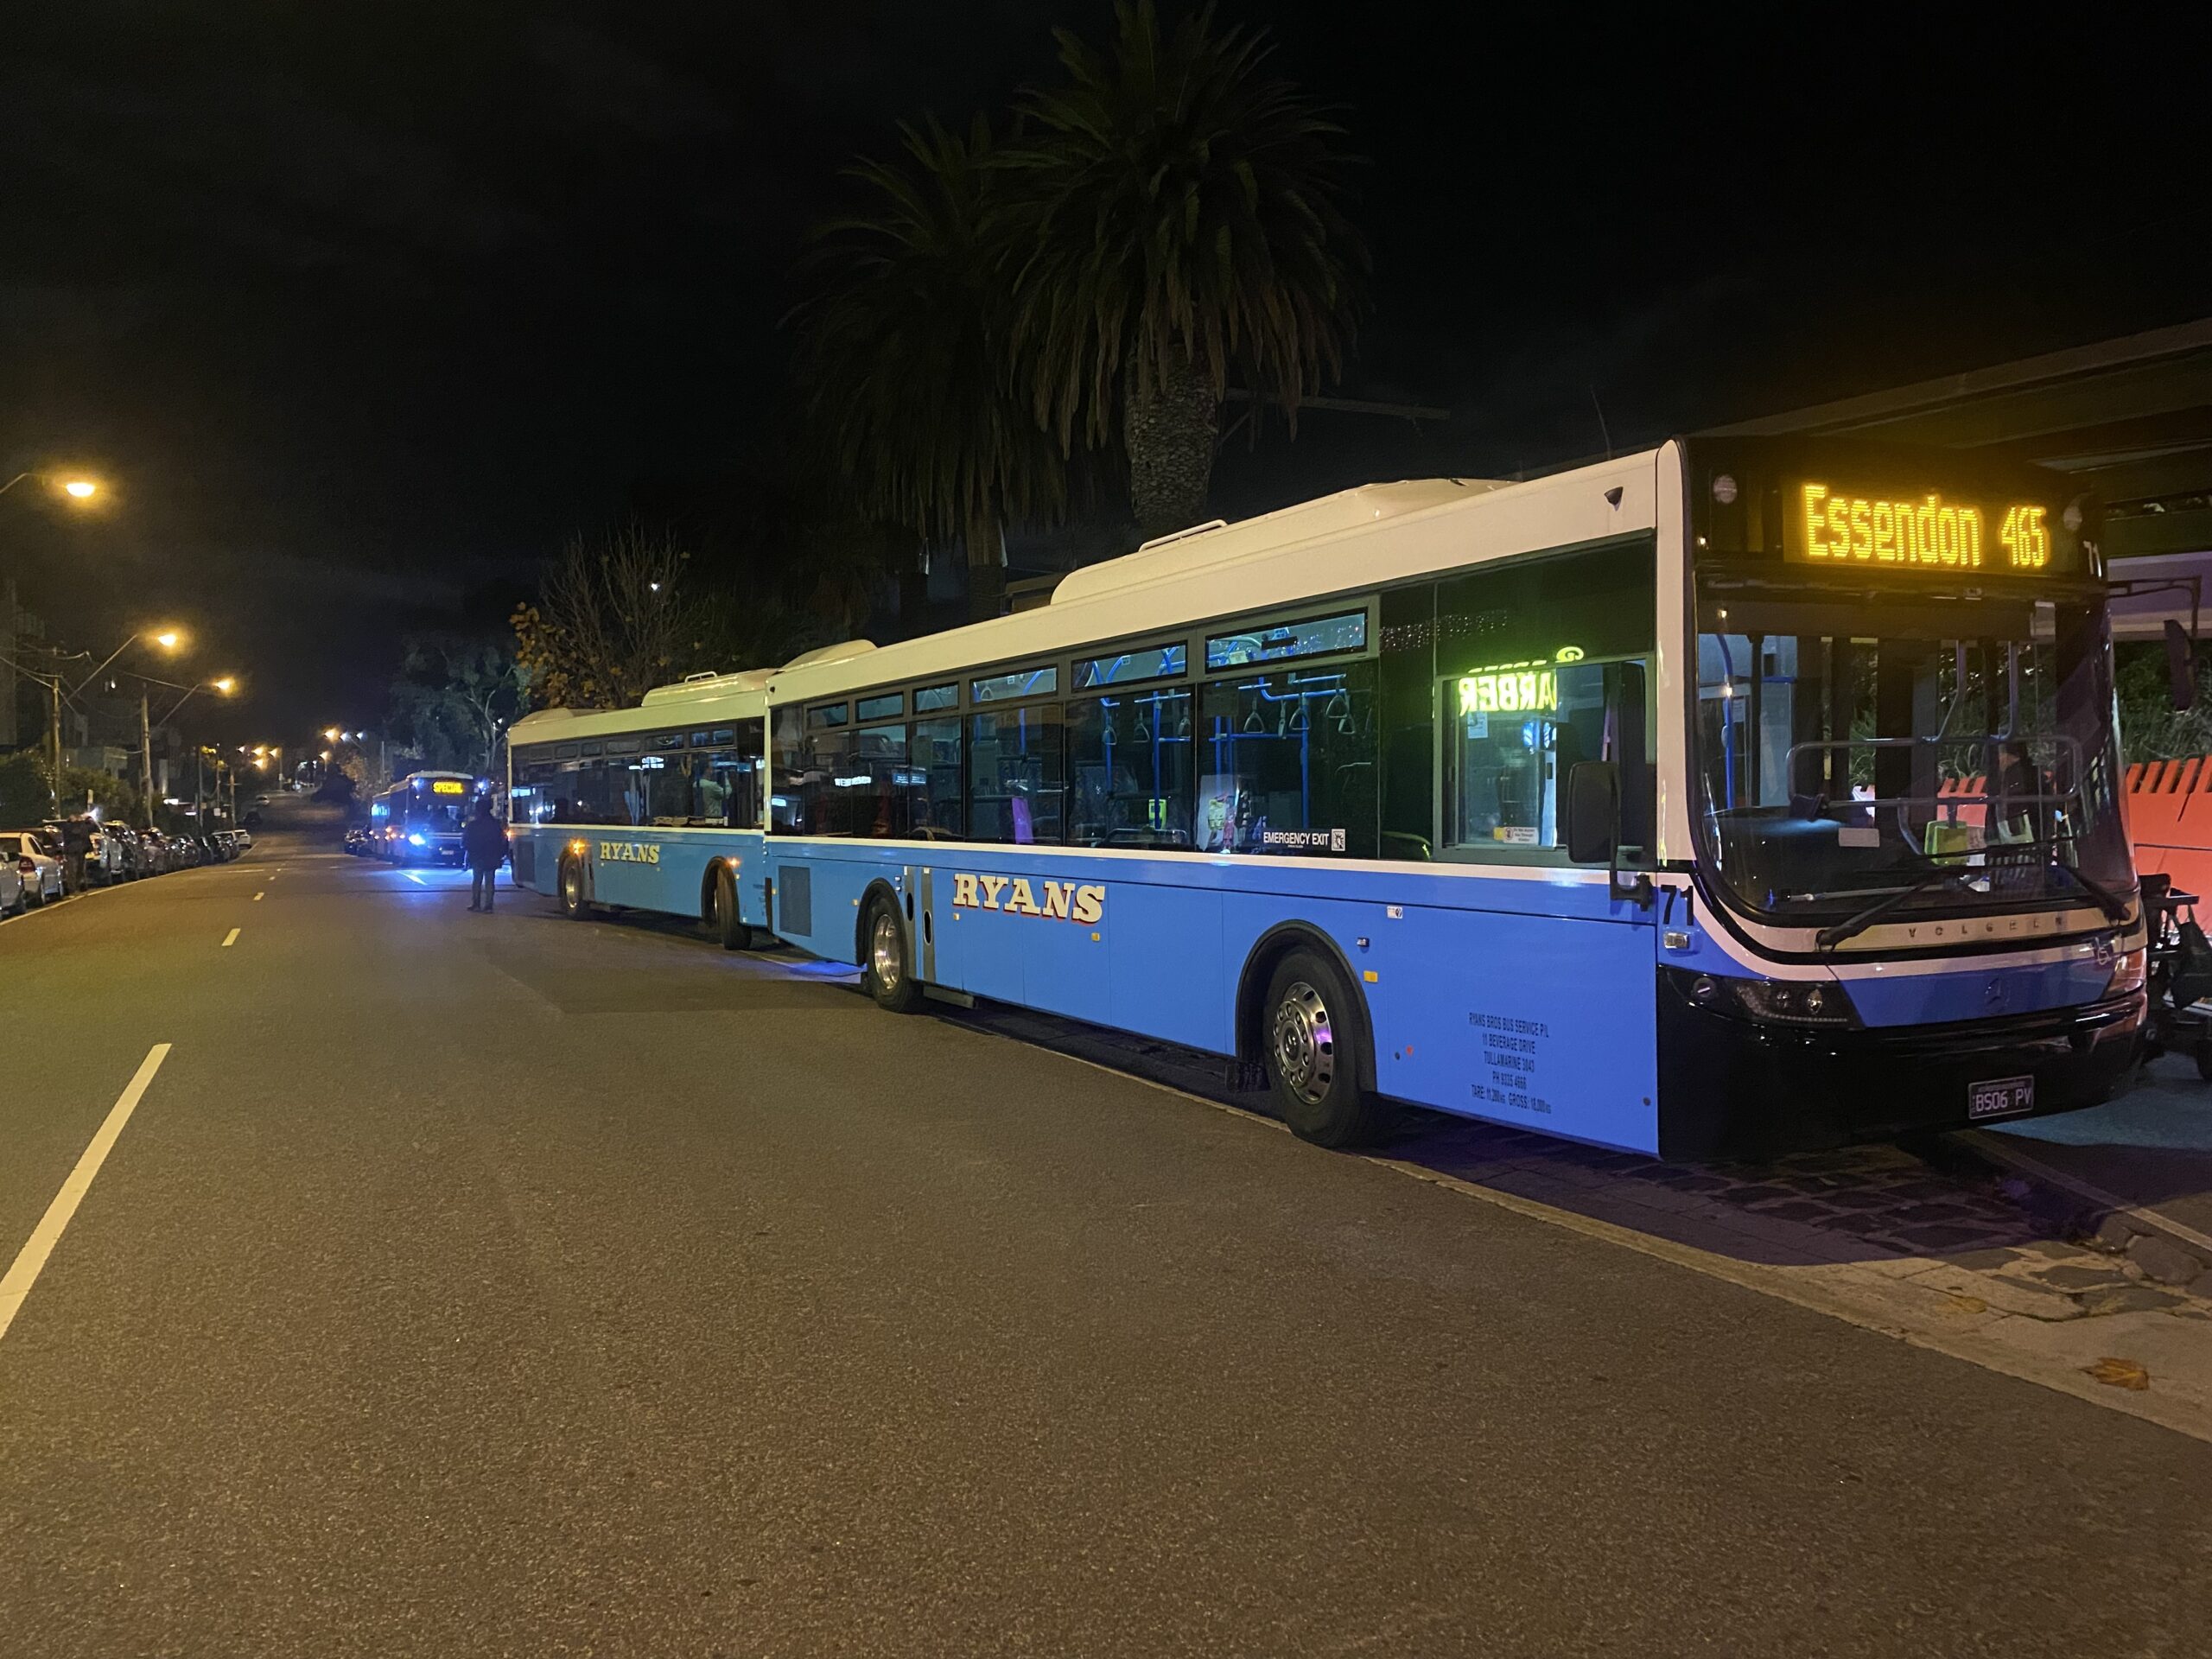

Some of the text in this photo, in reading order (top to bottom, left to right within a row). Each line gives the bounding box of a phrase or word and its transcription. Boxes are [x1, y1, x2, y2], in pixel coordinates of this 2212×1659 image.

[1804, 486, 2046, 568] Essendon 465
[433, 781, 463, 793] SPECIAL
[1263, 831, 1330, 846] EMERGENCY EXIT
[600, 842, 660, 864] RYANS
[952, 873, 1106, 925] RYANS
[1660, 884, 1694, 926] 71
[1469, 1012, 1485, 1027] RYANS
[1486, 1014, 1502, 1030] BROS
[1503, 1017, 1514, 1032] BUS
[1515, 1020, 1539, 1036] SERVICE
[1482, 1033, 1535, 1054] 11 BEVERAGE DRIVE
[1484, 1051, 1521, 1071] TULLAMARINE
[1492, 1071, 1500, 1084] PH
[1509, 1092, 1529, 1109] GROSS:
[1975, 1090, 2009, 1112] BS06
[2015, 1088, 2031, 1106] PV
